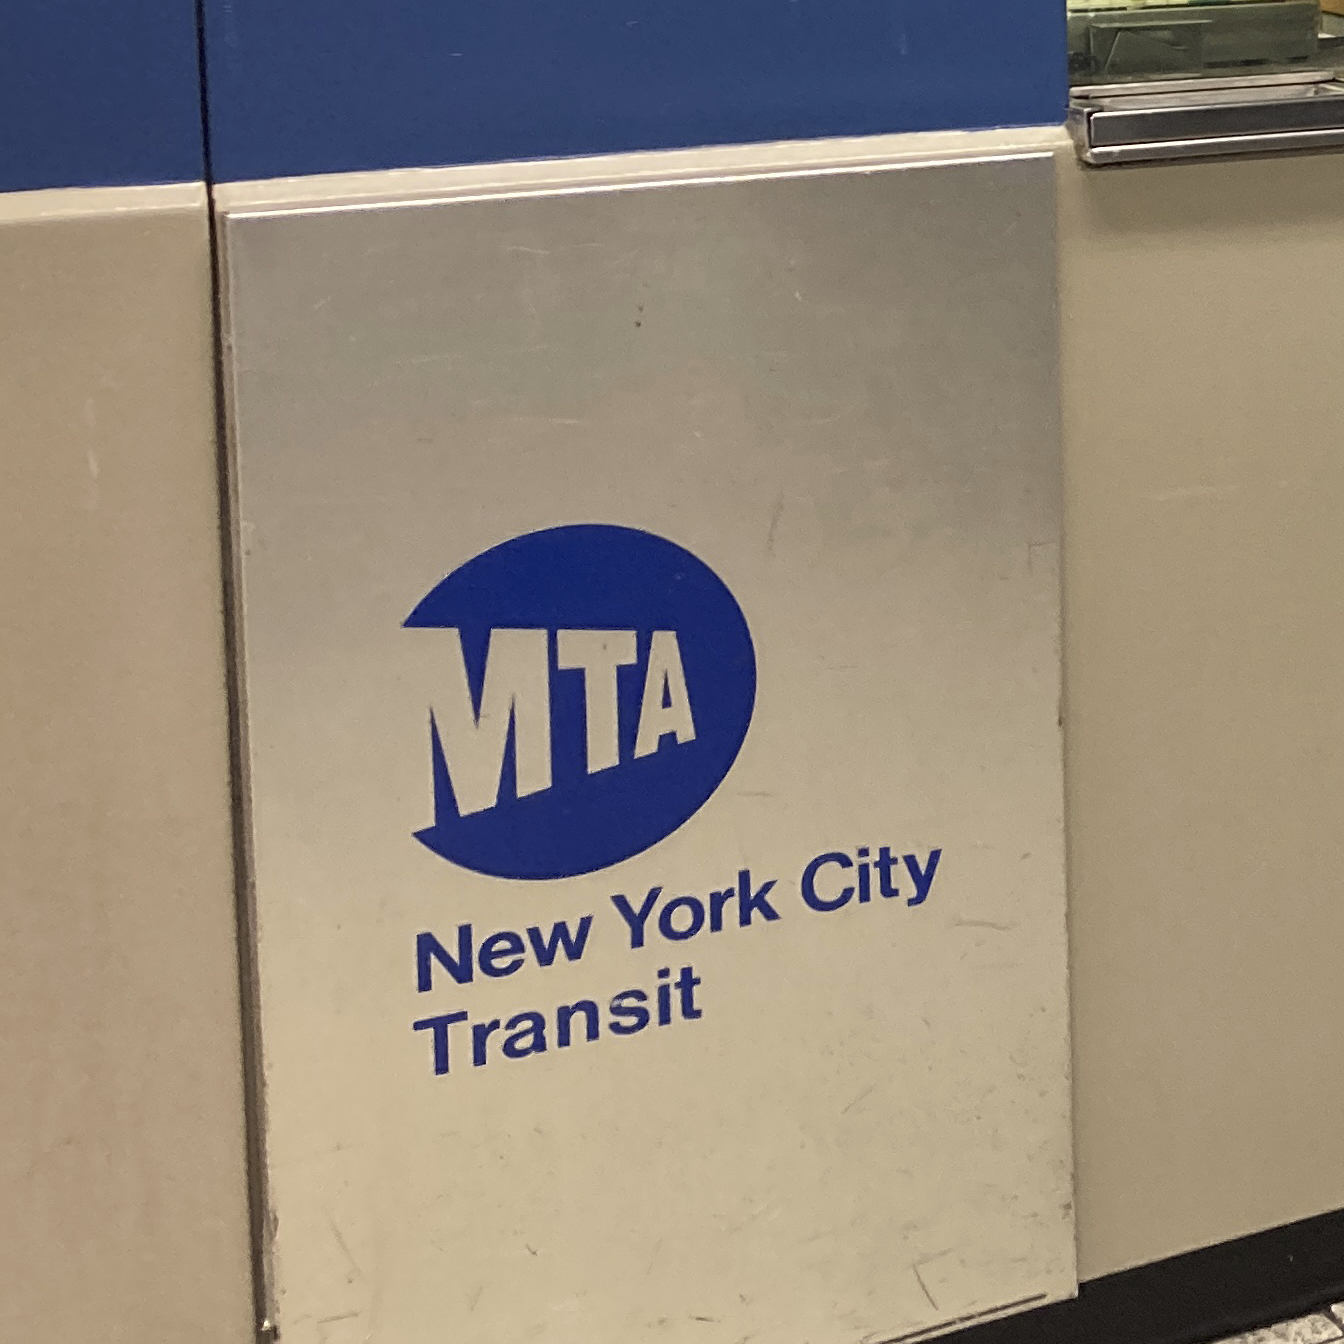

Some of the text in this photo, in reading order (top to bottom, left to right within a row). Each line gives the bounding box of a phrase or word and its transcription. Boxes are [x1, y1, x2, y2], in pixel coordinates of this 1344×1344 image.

[415, 846, 943, 993] New York City
[413, 967, 702, 1076] Transit
